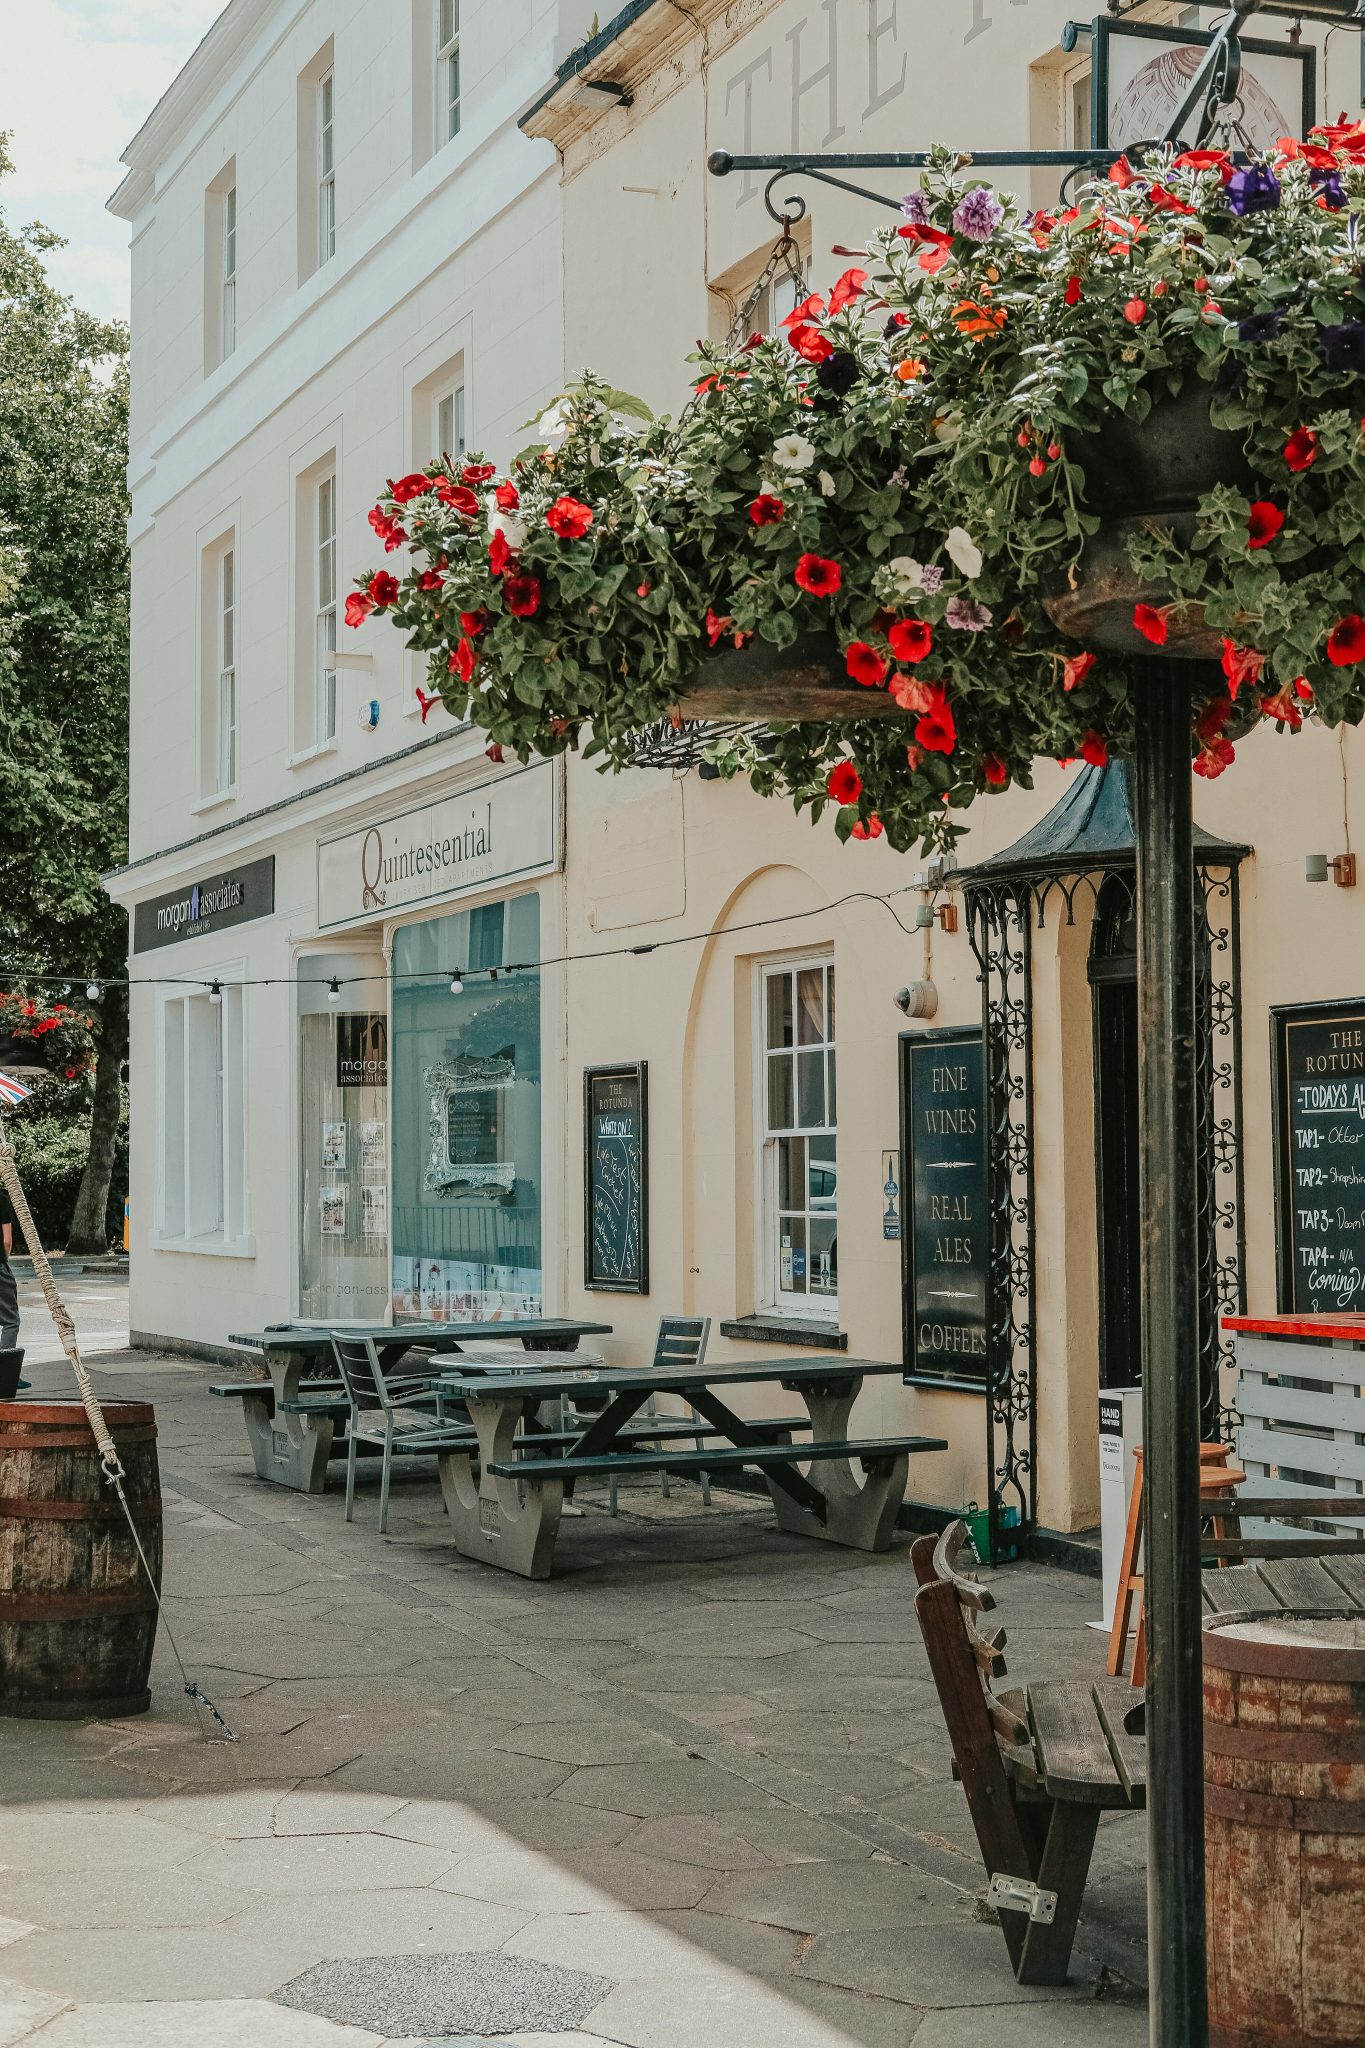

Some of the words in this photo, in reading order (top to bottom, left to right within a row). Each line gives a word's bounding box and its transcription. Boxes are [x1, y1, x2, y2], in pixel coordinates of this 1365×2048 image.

[725, 0, 907, 210] THE
[362, 803, 493, 911] Quintessential
[157, 900, 191, 932] morgan
[200, 879, 241, 917] associates
[1329, 1030, 1363, 1049] THE
[341, 1060, 388, 1074] morga
[1305, 1052, 1364, 1073] ROTUN
[608, 1084, 623, 1096] THE
[932, 1066, 968, 1092] FINE
[599, 1098, 633, 1110] ROTUNDA
[925, 1108, 977, 1134] WINES
[1328, 1126, 1364, 1144] Otter
[931, 1195, 973, 1221] REAL
[1336, 1206, 1361, 1230] Doom
[933, 1237, 973, 1264] ALES
[1339, 1248, 1354, 1264] N/A
[1308, 1266, 1361, 1307] Coming
[920, 1323, 987, 1356] COFFEES
[1101, 1406, 1120, 1419] HAND
